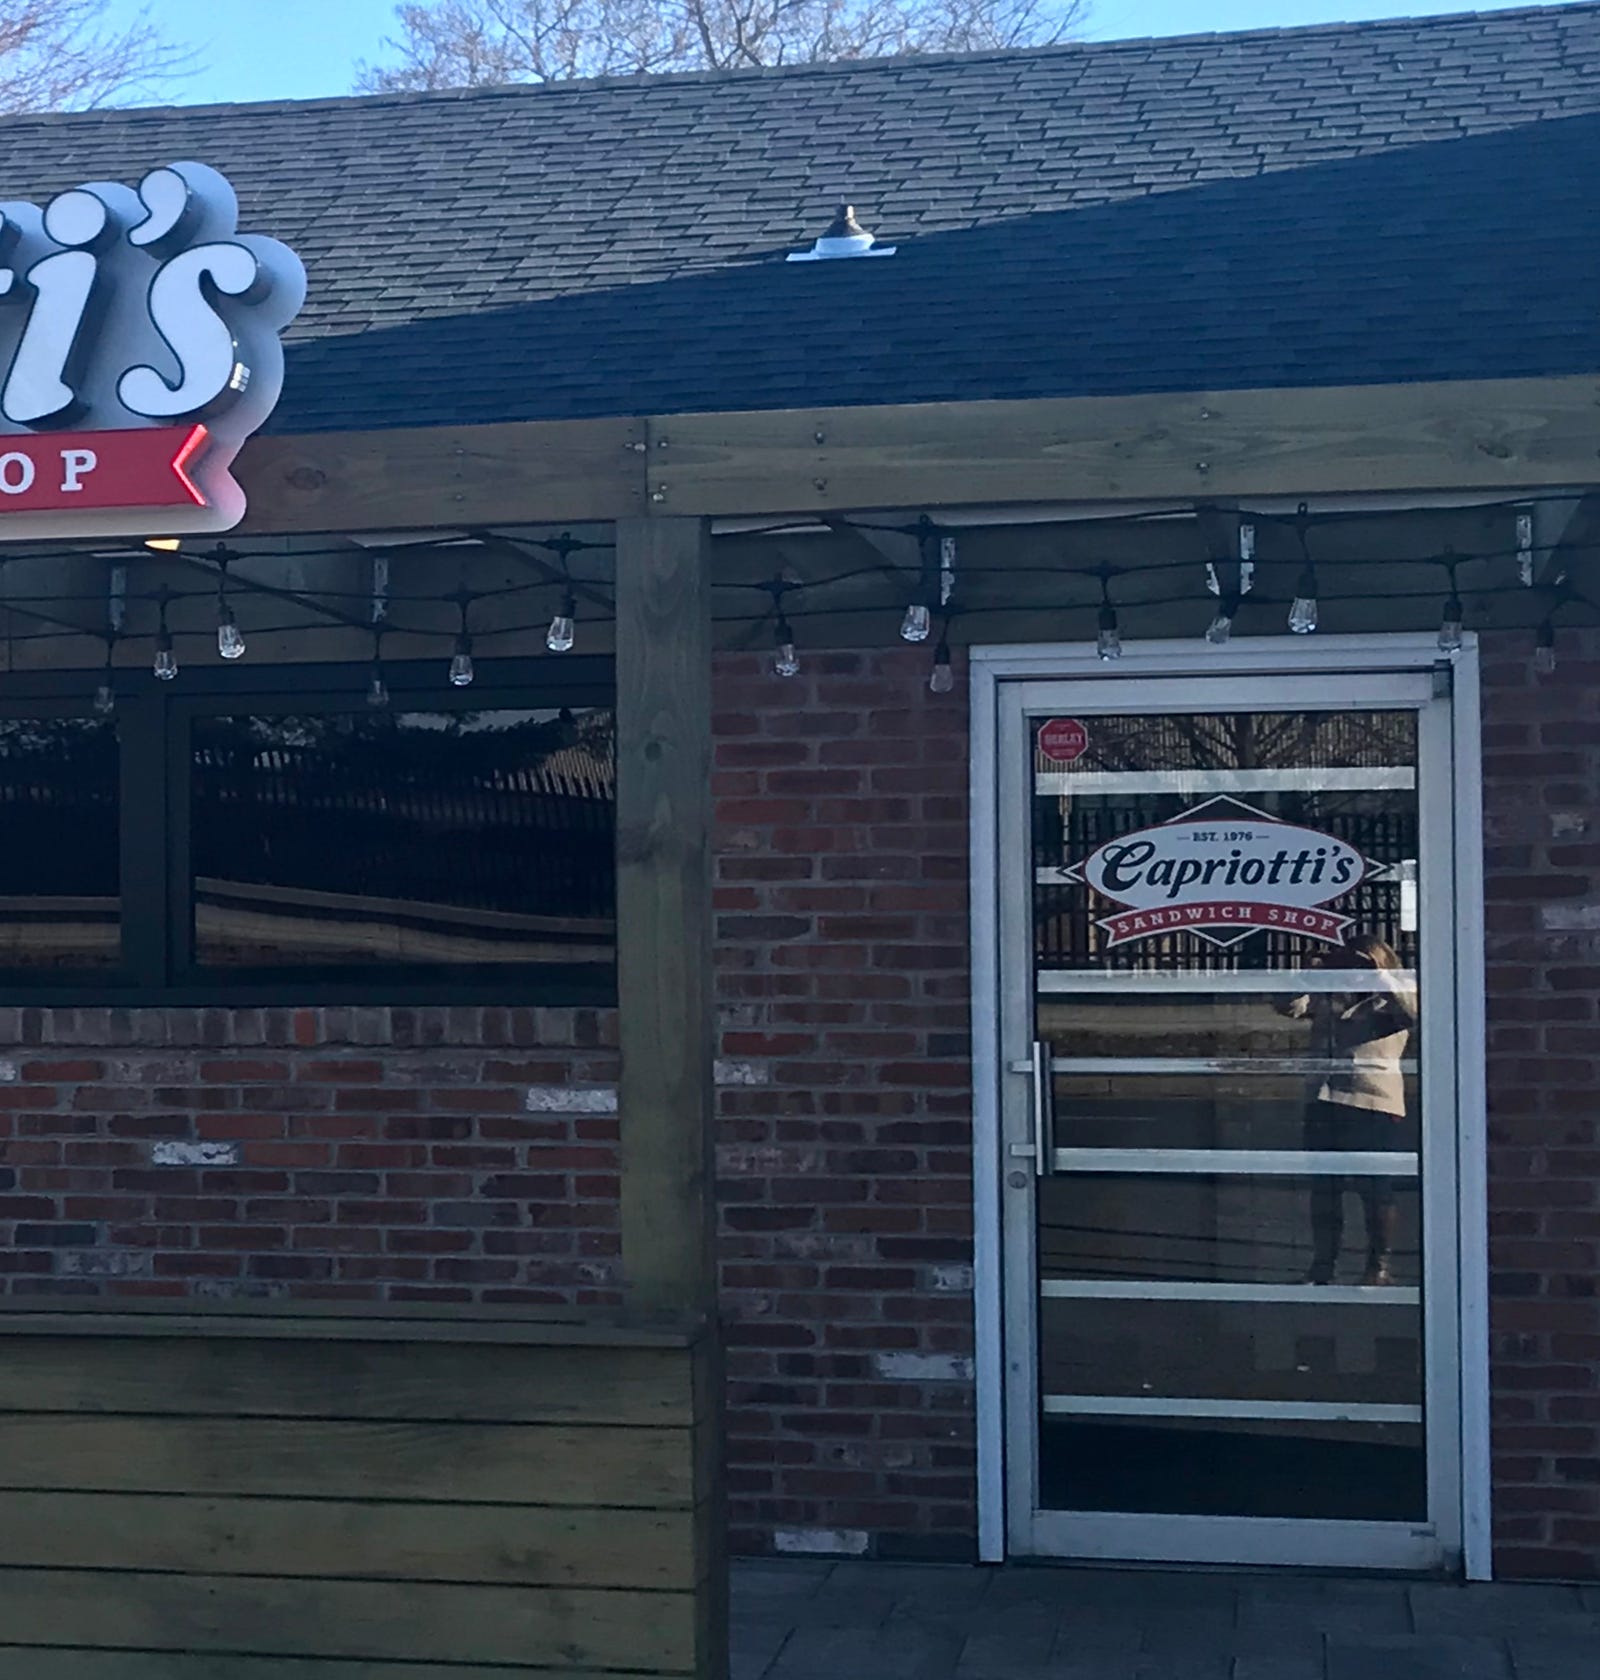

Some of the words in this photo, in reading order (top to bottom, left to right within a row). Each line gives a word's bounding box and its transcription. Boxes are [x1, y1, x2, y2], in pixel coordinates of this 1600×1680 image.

[1192, 831, 1220, 842] EST.
[1223, 831, 1254, 842] 1976
[1101, 841, 1355, 899] Capriotti's
[1117, 905, 1253, 933] SANDWICH
[1267, 908, 1336, 932] SHOP
